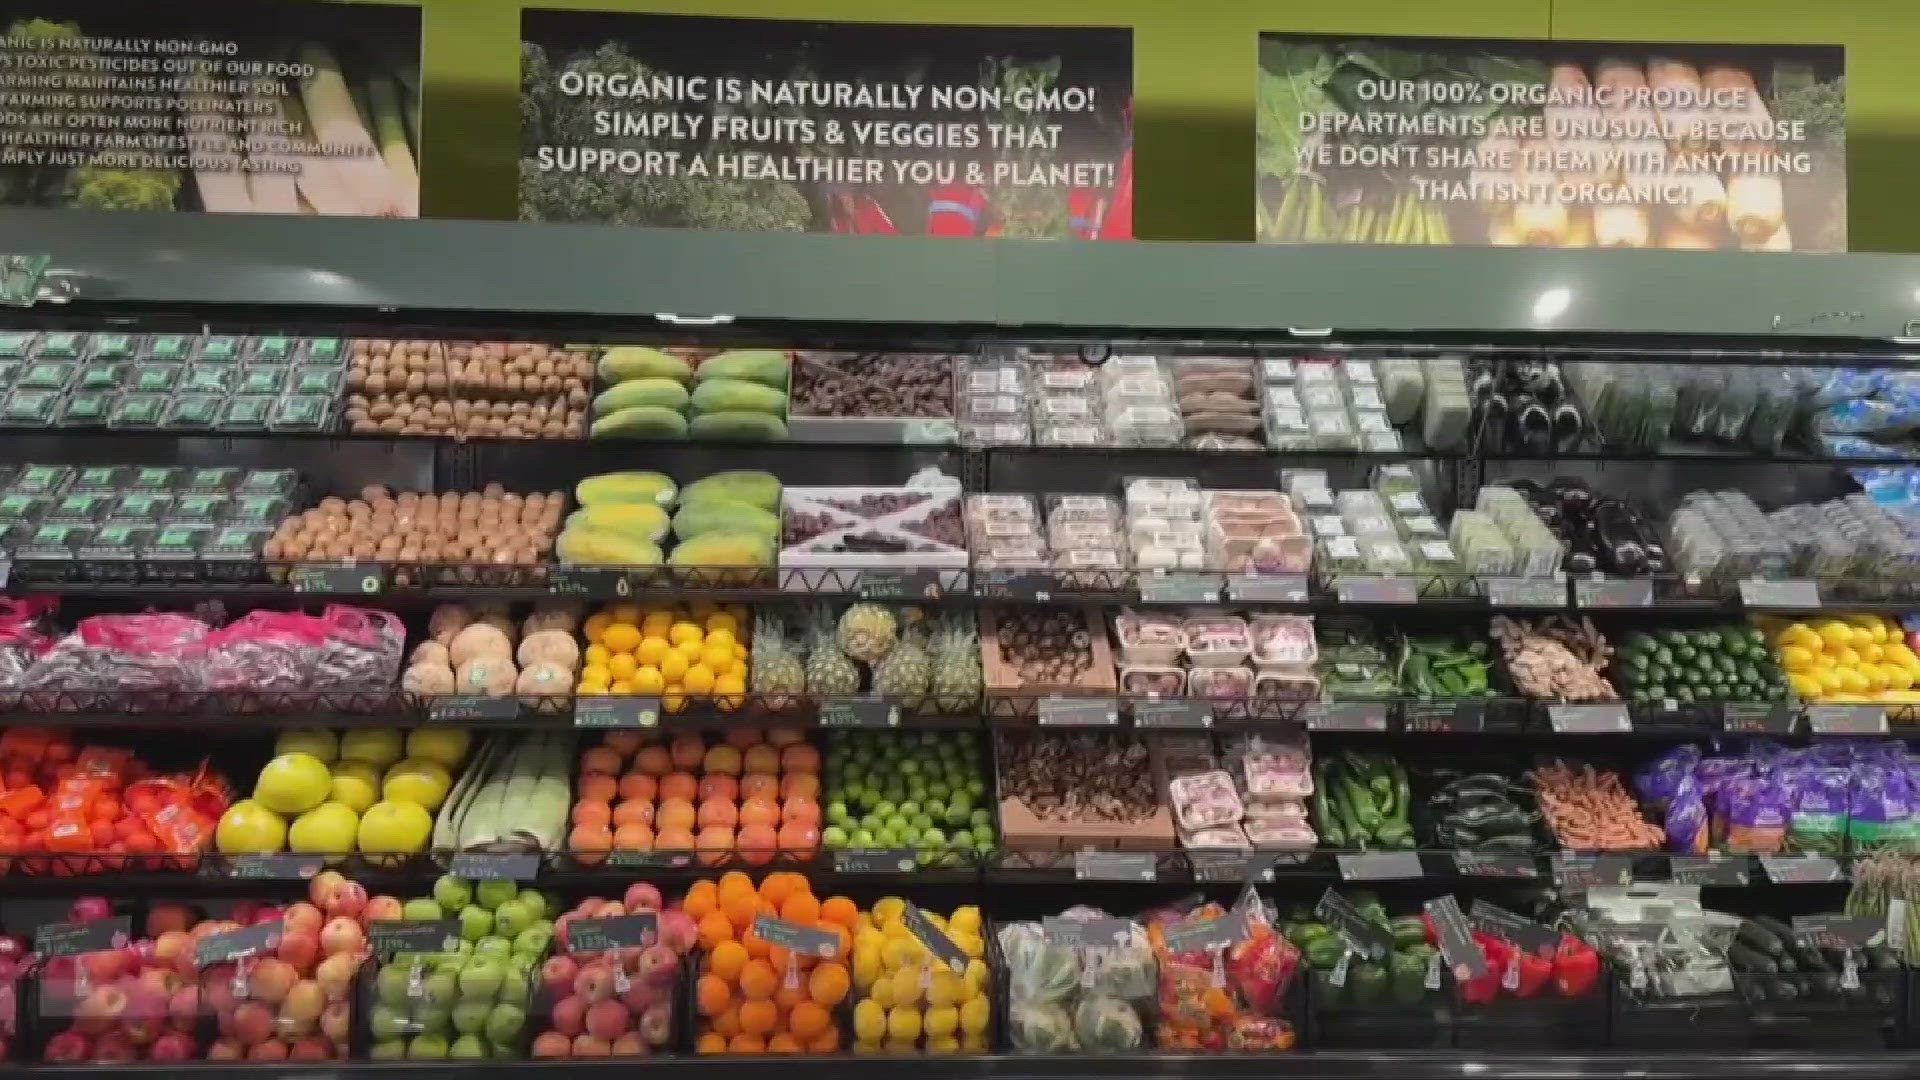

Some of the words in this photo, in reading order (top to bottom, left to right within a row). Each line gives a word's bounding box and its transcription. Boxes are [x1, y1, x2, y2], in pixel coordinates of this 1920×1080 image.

[41, 38, 54, 50] IS
[60, 39, 149, 52] NATURALLY
[155, 40, 238, 56] NON-GMO
[17, 55, 66, 70] TOXIC
[69, 56, 159, 72] PESTICIDES
[163, 58, 197, 73] OUT
[201, 60, 222, 73] OF
[226, 62, 262, 75] OUR
[268, 63, 314, 77] FOOD
[66, 76, 156, 91] MAINTAINS
[160, 78, 249, 94] HEALTHIER
[253, 82, 288, 96] SOIL
[559, 71, 708, 100] ORGANIC
[716, 77, 742, 104] IS
[751, 79, 924, 110] NATURALLY
[932, 85, 1095, 112] NON-GMO!
[1356, 79, 1416, 102] OUR
[1418, 80, 1482, 104] 100%
[1489, 83, 1614, 106] ORGANIC
[1622, 86, 1746, 108] PRODUCE
[80, 95, 161, 110] SUPPORTS
[30, 114, 63, 128] ARE
[66, 114, 120, 128] OFTEN
[124, 116, 171, 130] MORE
[177, 117, 257, 133] NUTRIENT
[262, 120, 302, 135] RICH
[594, 111, 704, 140] SIMPLY
[712, 115, 816, 143] FRUITS
[824, 120, 845, 144] &
[852, 120, 980, 148] VEGGIES
[987, 124, 1062, 149] THAT
[1299, 111, 1486, 136] DEPARTMENTS
[1495, 116, 1545, 137] ARE
[1689, 120, 1808, 142] BECAUSE
[2, 132, 90, 146] HEALTHIER
[96, 133, 140, 149] FARM
[231, 138, 265, 153] AND
[48, 152, 84, 166] JUST
[90, 152, 136, 168] MORE
[142, 154, 228, 170] DELICIOUS
[236, 158, 301, 172] TASTING
[538, 145, 681, 176] SUPPORT
[688, 152, 709, 177] A
[718, 152, 884, 183] HEALTHIER
[892, 158, 956, 184] YOU
[965, 160, 984, 186] &
[993, 161, 1114, 188] PLANET!
[1293, 144, 1333, 166] WE
[1340, 144, 1420, 168] DON'T
[1426, 147, 1512, 169] SHARE
[1523, 149, 1592, 170] THEM
[1600, 150, 1666, 173] WITH
[1673, 152, 1812, 174] ANYTHING
[1415, 179, 1481, 201] THAT
[1488, 180, 1548, 202] ISN'T
[1558, 182, 1690, 205] ORGANIC!
